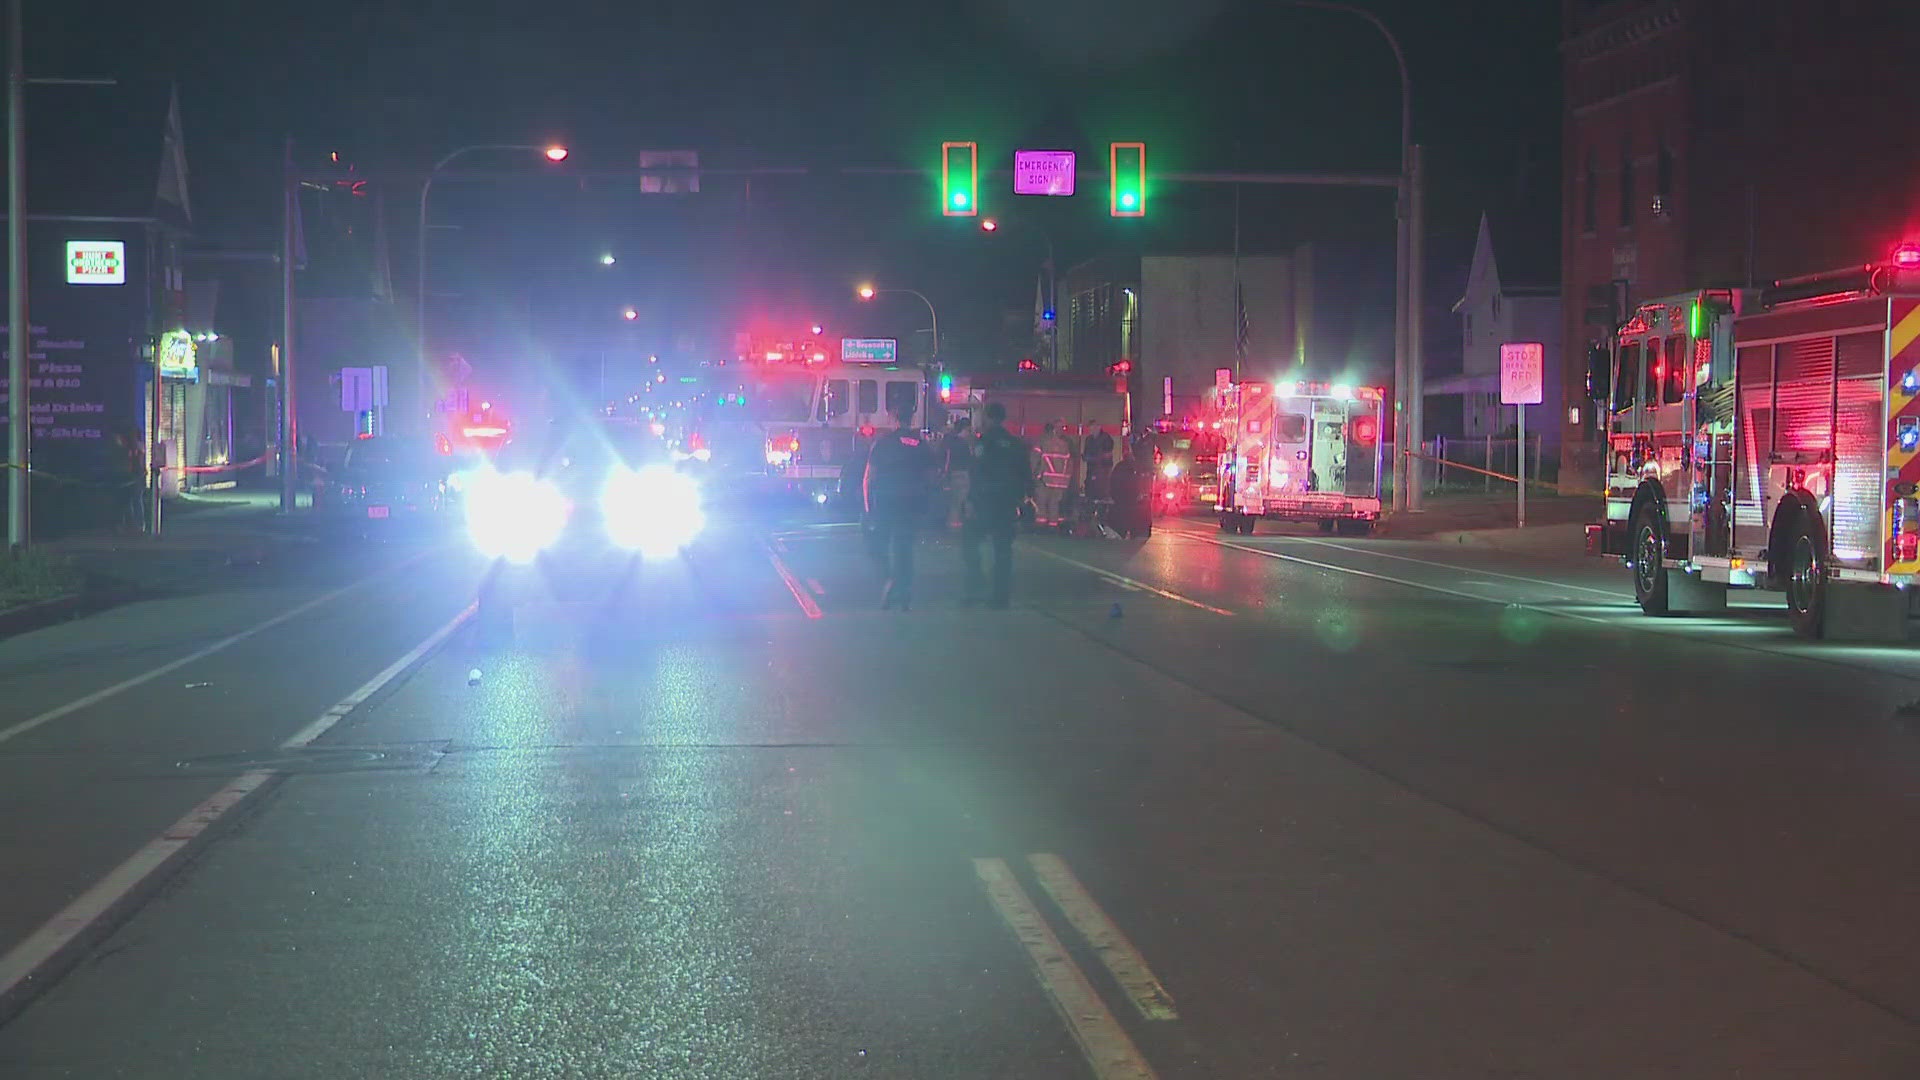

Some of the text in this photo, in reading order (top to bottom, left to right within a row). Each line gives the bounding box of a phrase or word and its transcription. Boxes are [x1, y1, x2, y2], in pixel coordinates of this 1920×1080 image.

[1019, 161, 1071, 171] EMERGENCY
[1028, 175, 1055, 185] SIGN
[1507, 351, 1536, 361] STOP
[1511, 371, 1532, 380] RED
